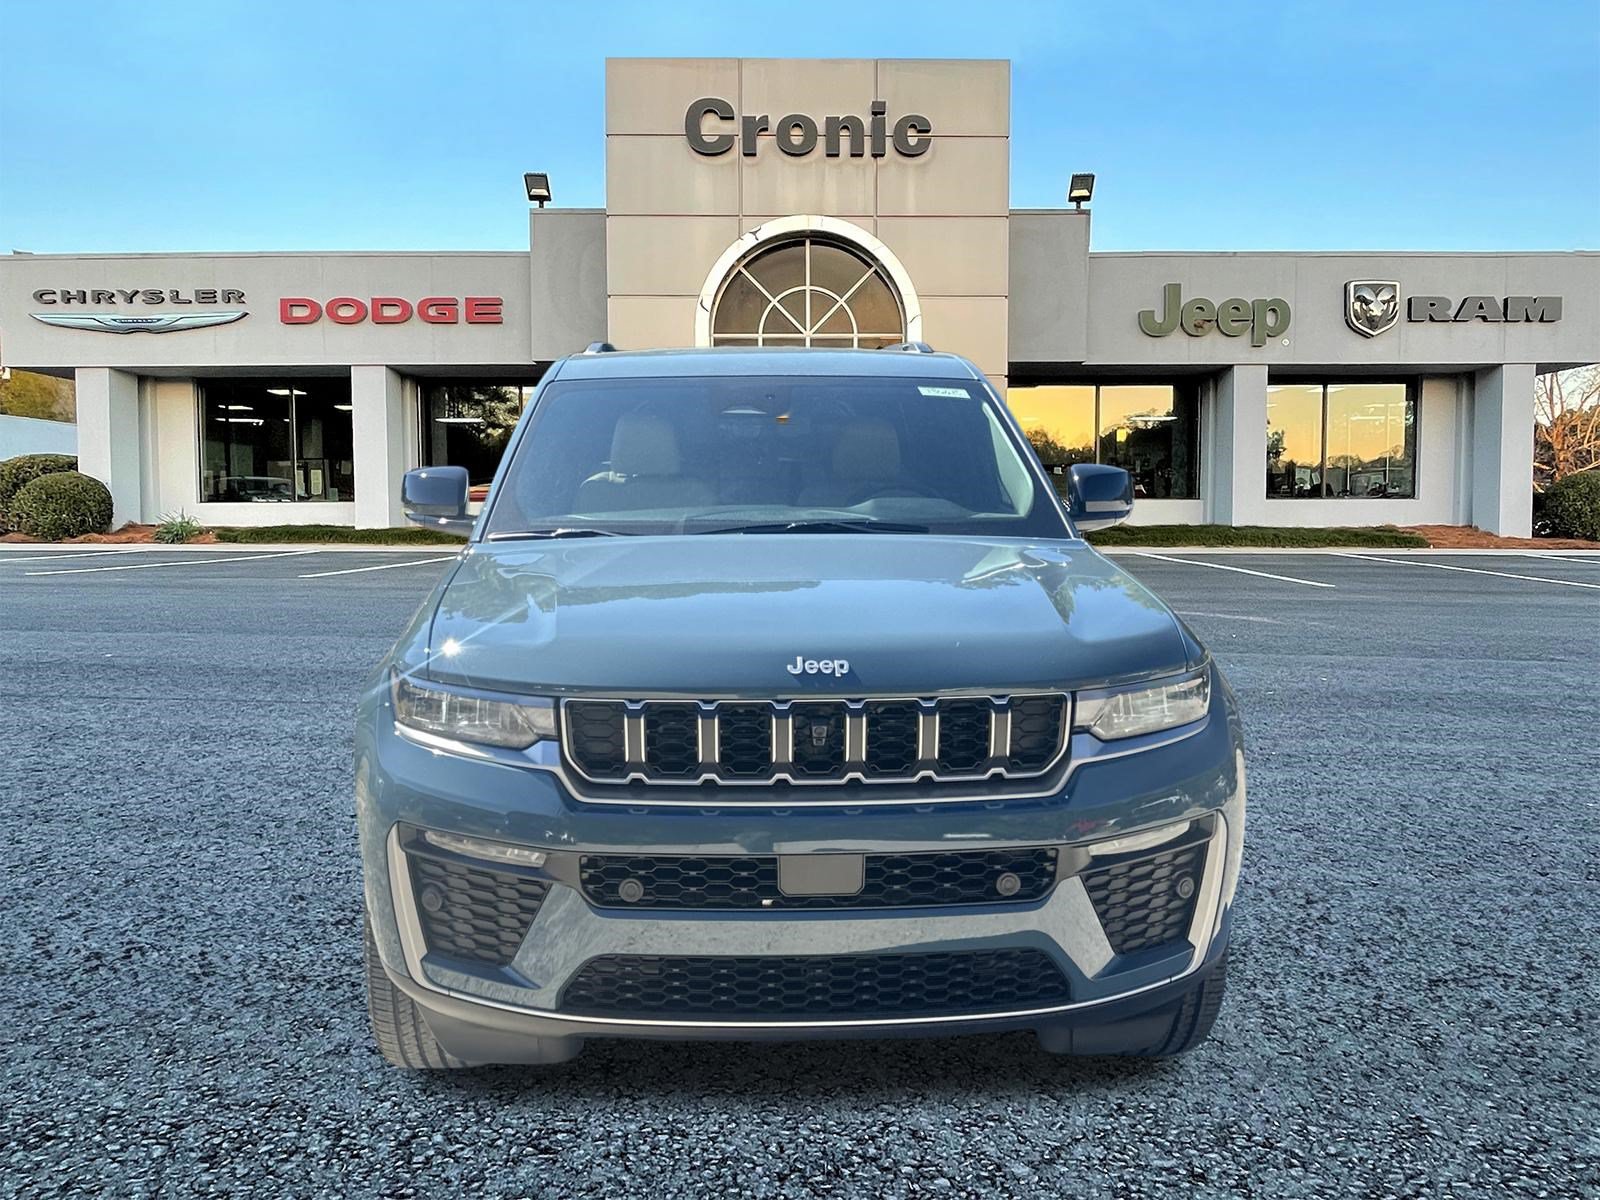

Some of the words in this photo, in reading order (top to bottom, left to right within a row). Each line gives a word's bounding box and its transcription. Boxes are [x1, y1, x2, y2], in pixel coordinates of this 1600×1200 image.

[685, 97, 932, 157] Cronic
[33, 288, 247, 305] CHRYSLER
[1408, 296, 1562, 322] RAM
[280, 297, 504, 324] DODGE
[1138, 283, 1292, 346] Jeep
[787, 656, 849, 677] Jeep
